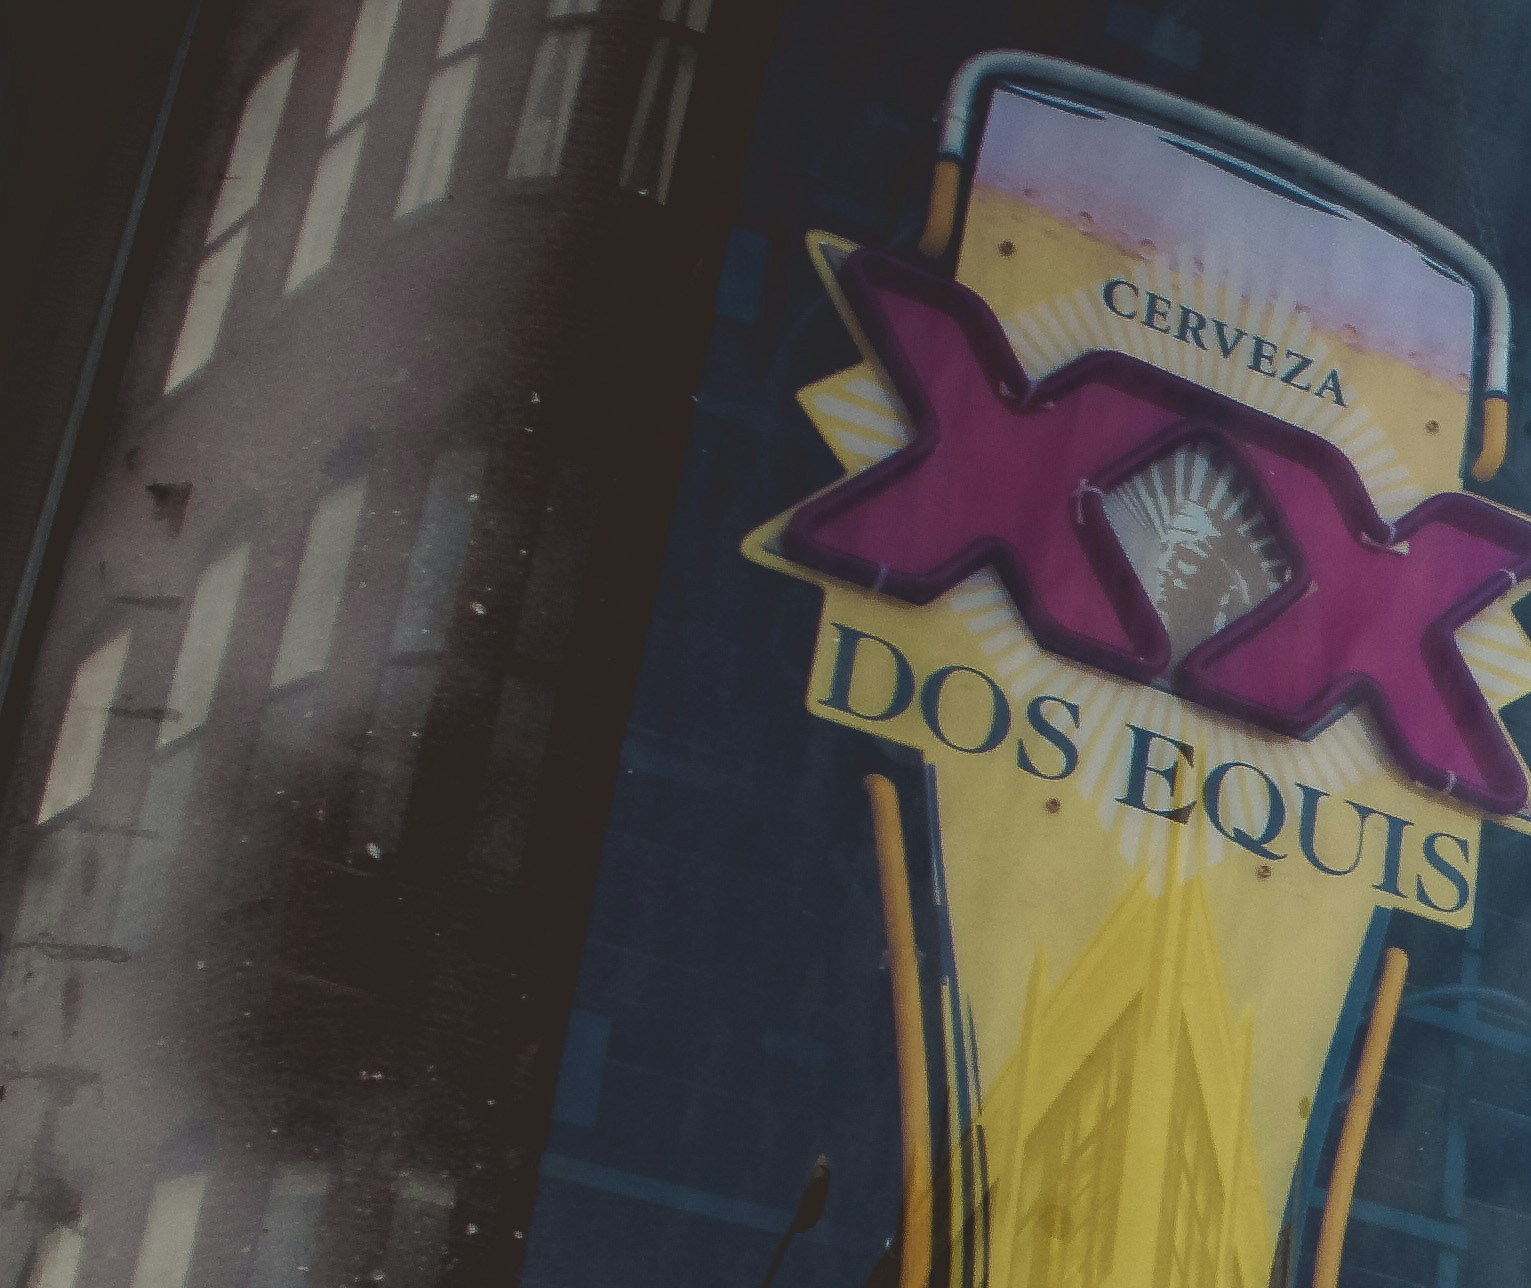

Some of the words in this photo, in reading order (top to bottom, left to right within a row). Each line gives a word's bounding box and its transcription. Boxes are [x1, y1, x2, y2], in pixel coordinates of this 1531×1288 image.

[1101, 278, 1348, 408] CERVEZA
[819, 621, 1082, 782] DOS
[1114, 722, 1474, 914] EQUIS
